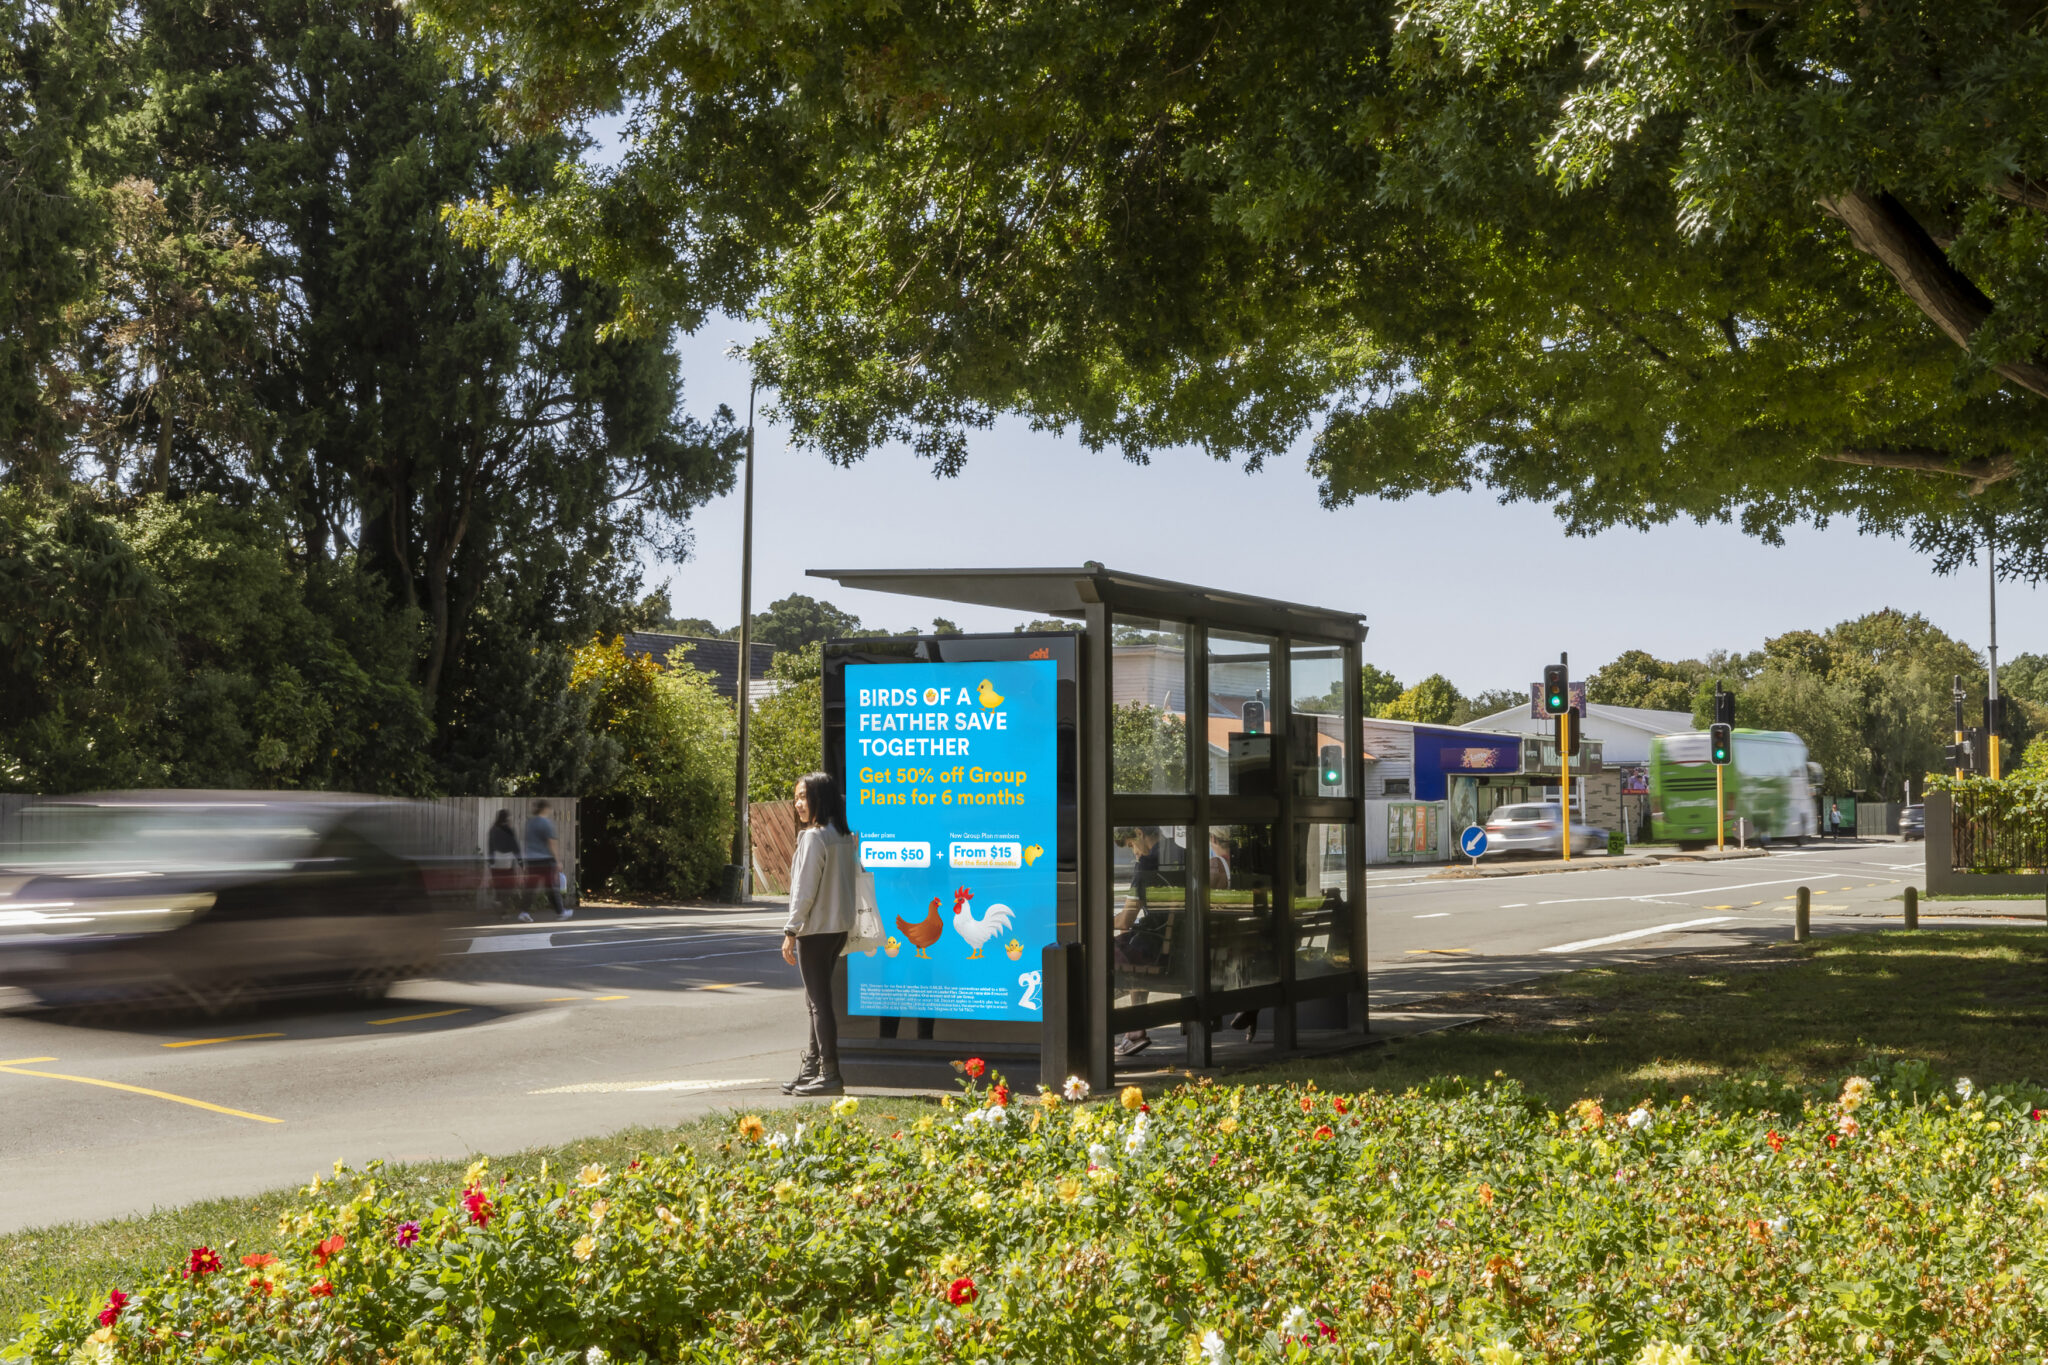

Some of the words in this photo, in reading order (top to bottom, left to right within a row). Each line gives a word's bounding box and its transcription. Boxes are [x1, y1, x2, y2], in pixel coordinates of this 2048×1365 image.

[859, 687, 918, 707] BIRDS
[922, 687, 951, 706] OF
[956, 687, 972, 705] A
[859, 712, 949, 732] FEATHER
[954, 712, 1007, 731] SAVE
[858, 738, 970, 756] TOGETHER
[859, 766, 892, 784] Get
[896, 767, 935, 784] 50%
[939, 766, 965, 784] off
[968, 766, 1028, 787] Group
[860, 788, 907, 806] Plans
[910, 788, 937, 805] for
[941, 789, 953, 805] 6
[957, 788, 1025, 806] months
[963, 832, 981, 841] Group
[981, 832, 994, 840] Plan
[865, 848, 897, 860] From
[901, 847, 924, 862] $50
[953, 845, 986, 858] From
[990, 844, 1012, 860] $15
